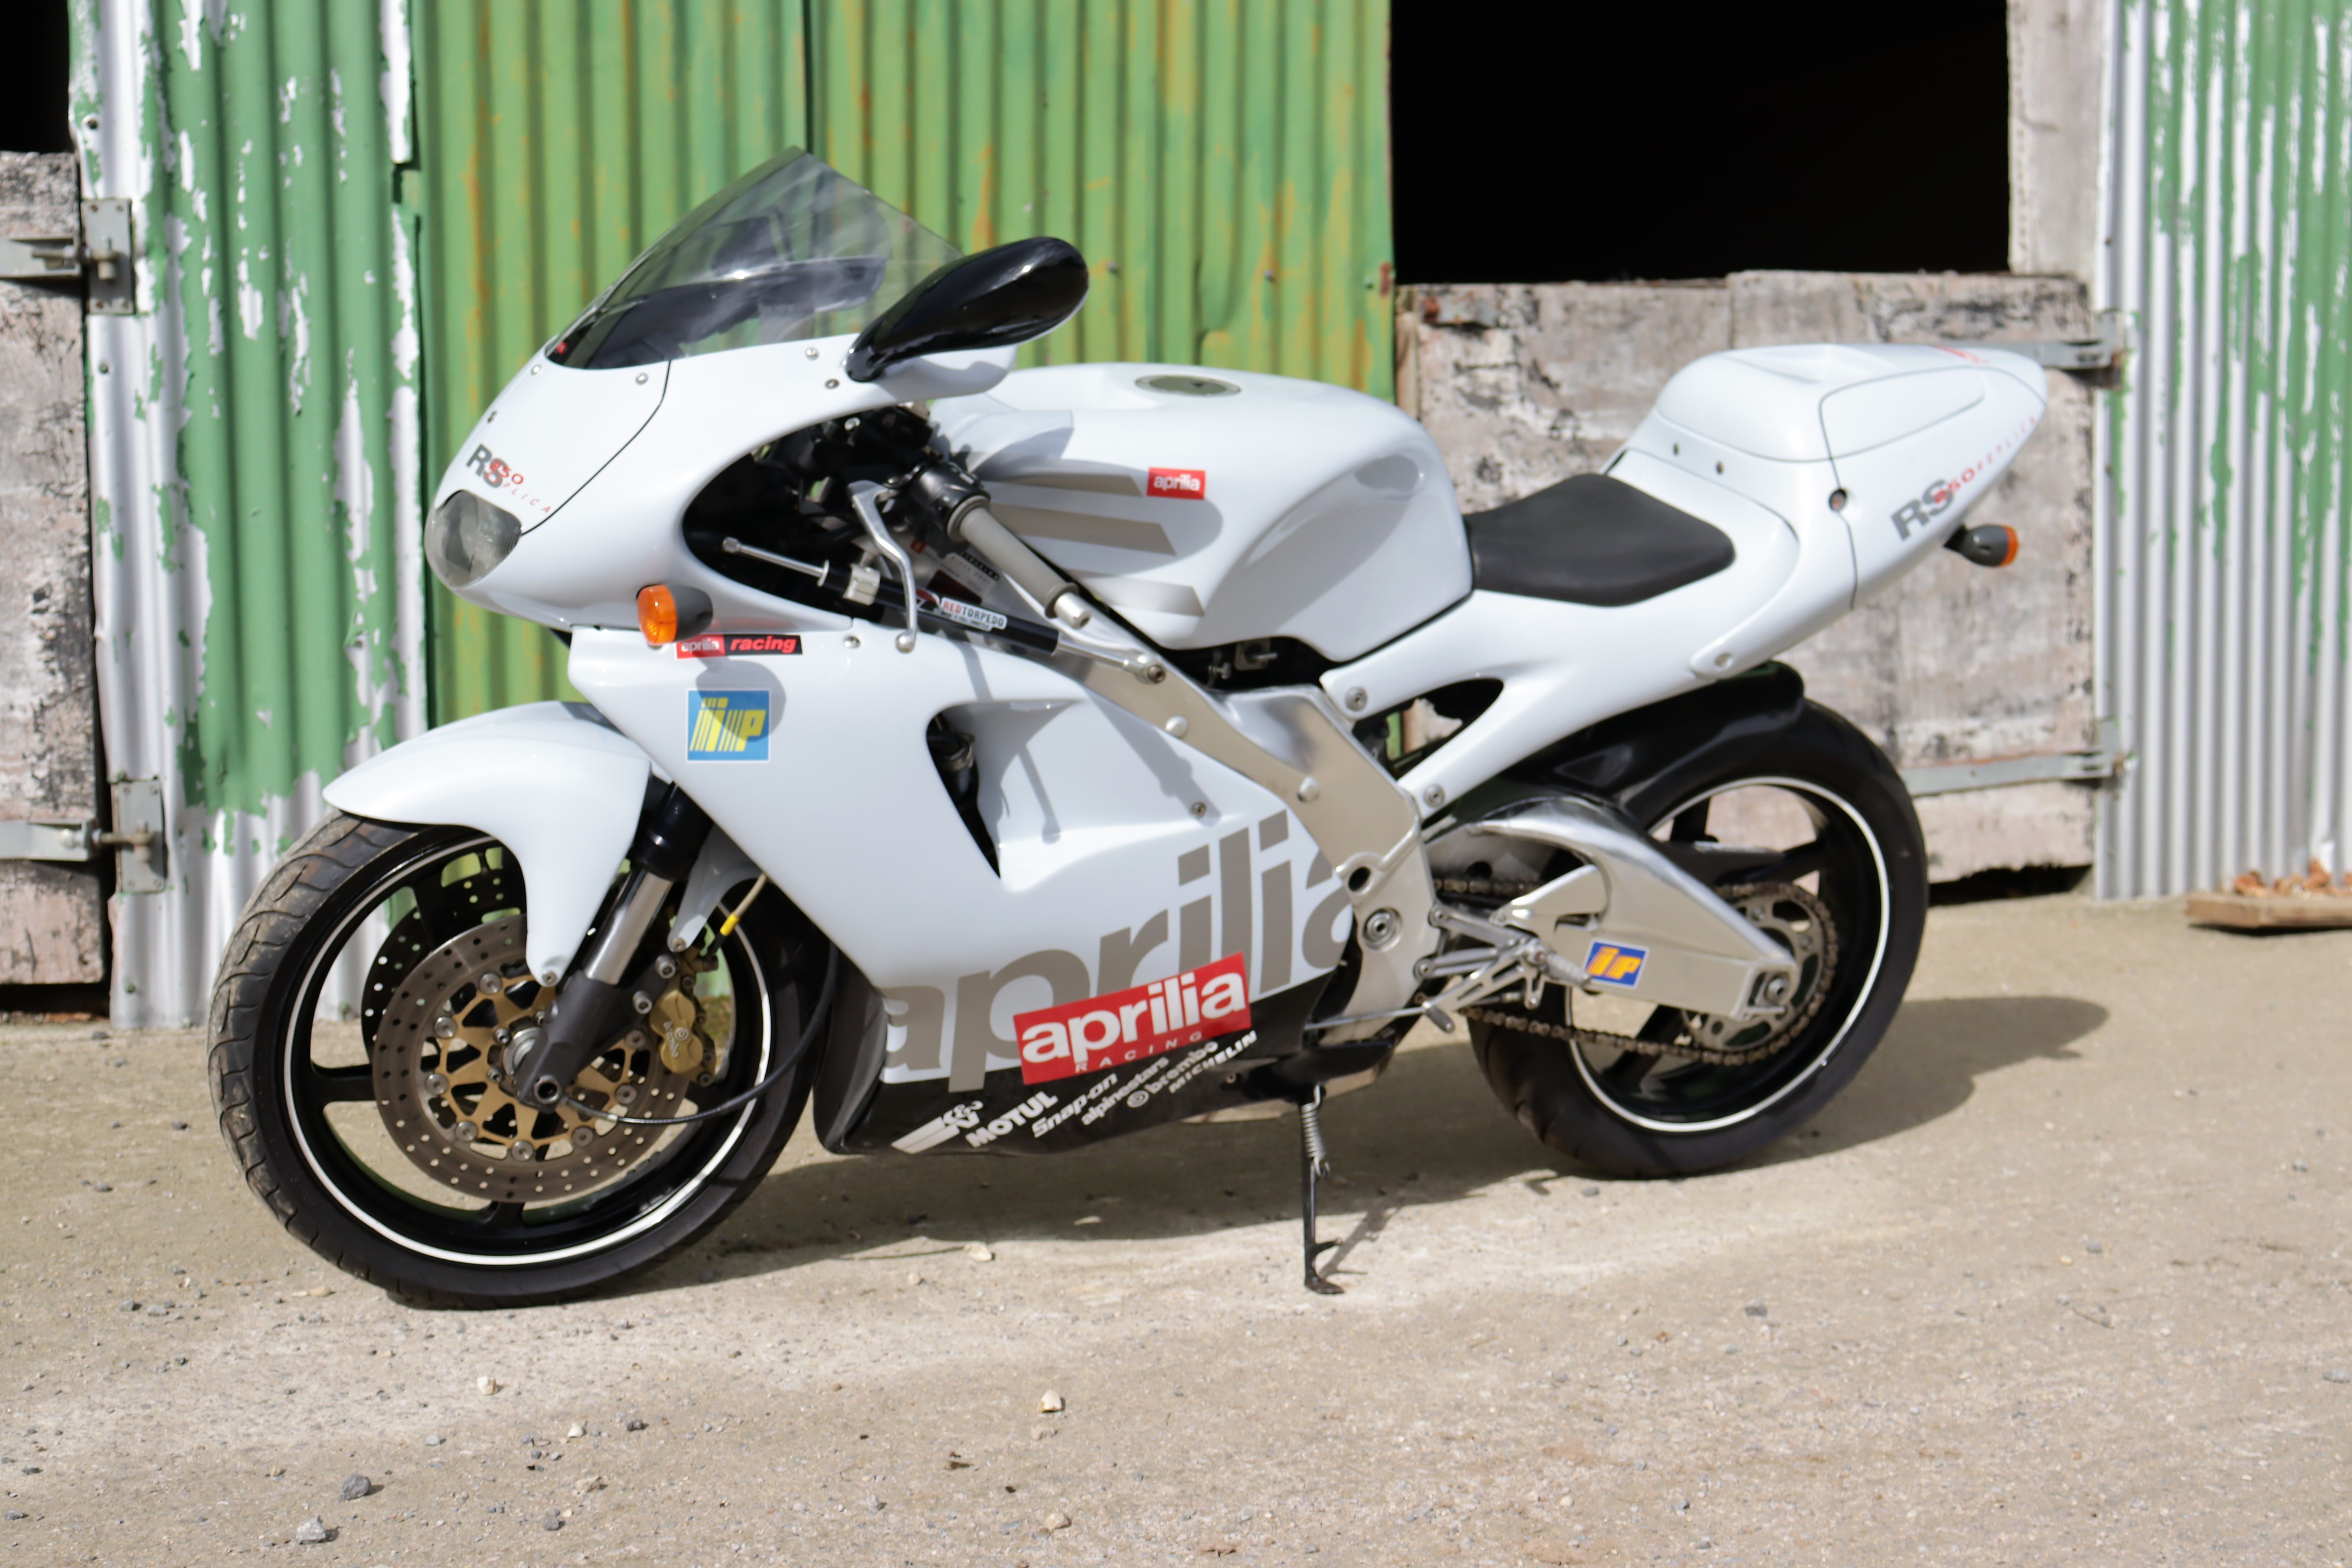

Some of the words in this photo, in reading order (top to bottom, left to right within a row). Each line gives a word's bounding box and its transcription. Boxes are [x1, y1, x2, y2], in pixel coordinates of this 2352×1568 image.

[466, 443, 509, 488] RS
[1154, 473, 1201, 491] aprilia
[1891, 479, 1955, 541] RS
[681, 638, 720, 653] aprilia
[730, 635, 797, 654] racing
[877, 809, 1353, 1093] aprilia
[1022, 972, 1246, 1063] aprilia
[1075, 1031, 1202, 1073] RACING
[1143, 1041, 1219, 1095] brembo
[1169, 1030, 1257, 1093] MICHELIN
[1082, 1056, 1169, 1125] alpinestars
[965, 1091, 1059, 1148] MOTUL
